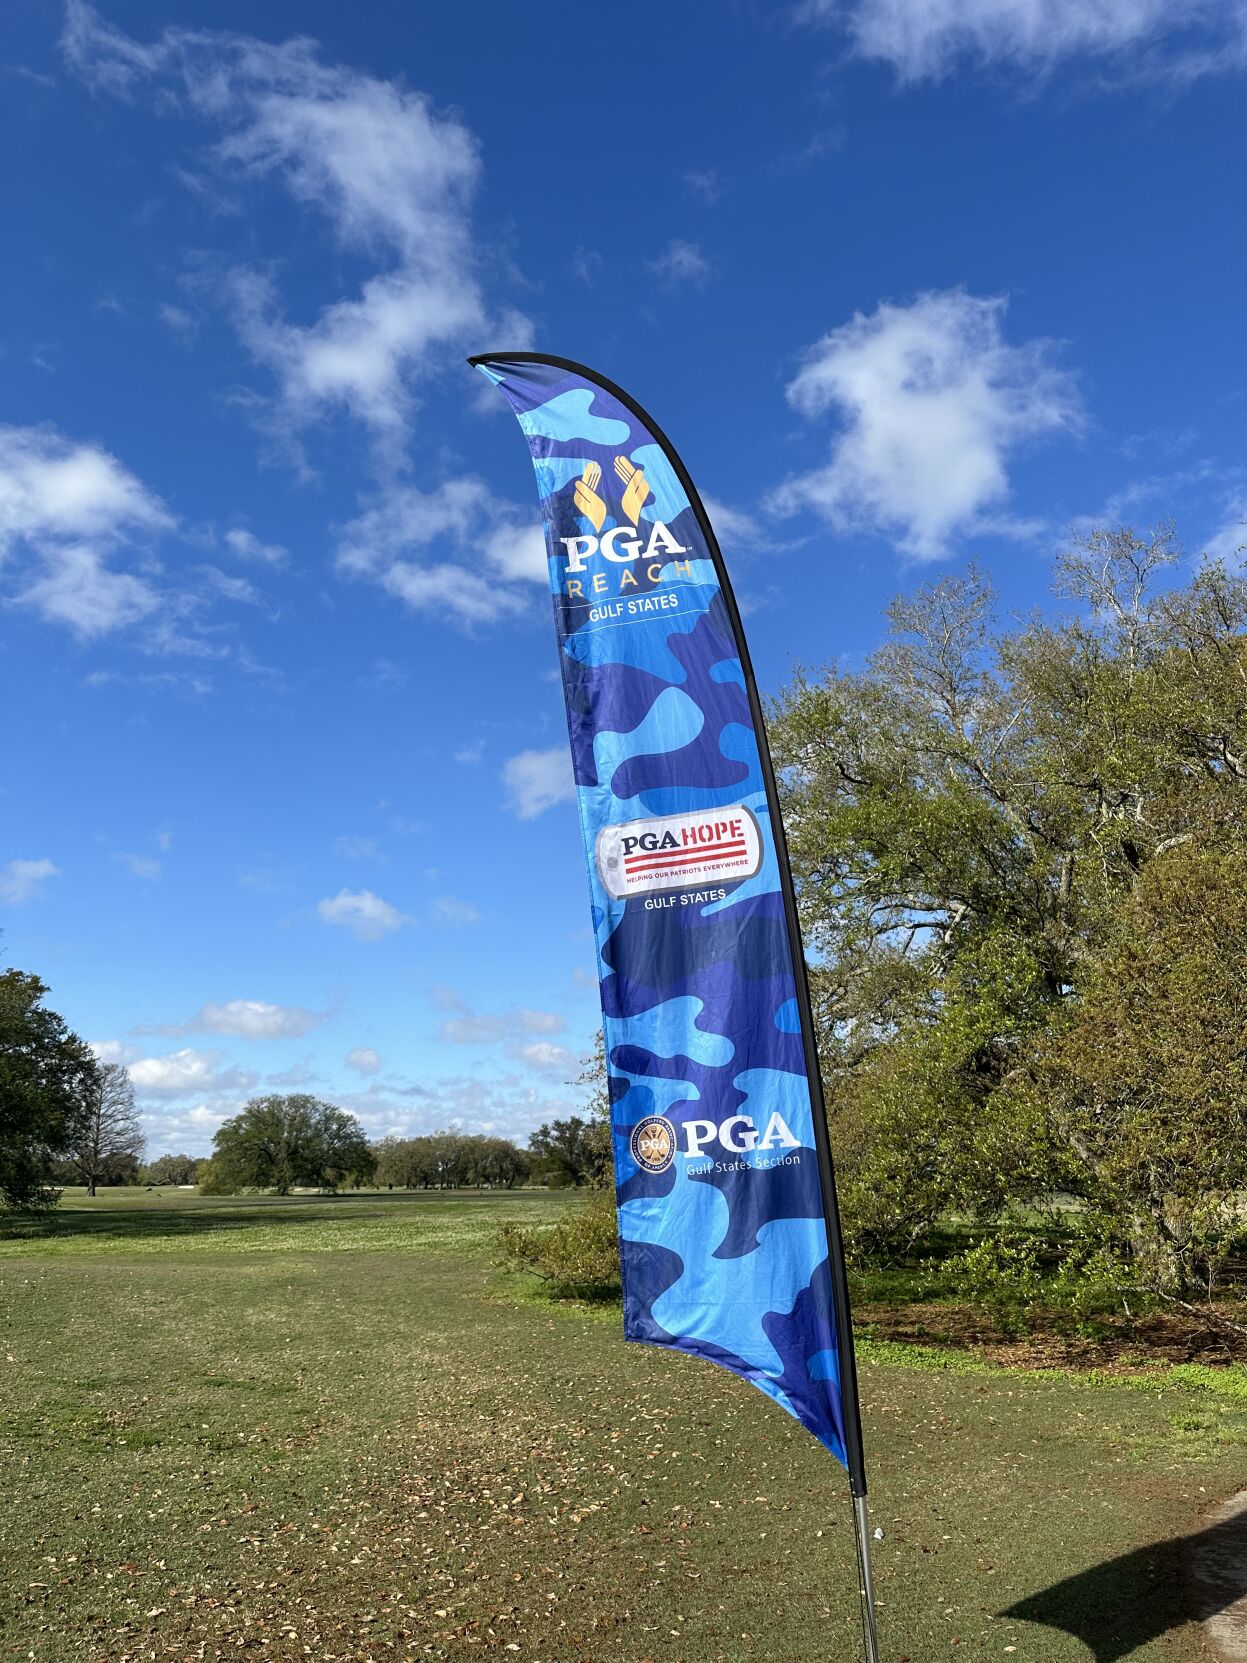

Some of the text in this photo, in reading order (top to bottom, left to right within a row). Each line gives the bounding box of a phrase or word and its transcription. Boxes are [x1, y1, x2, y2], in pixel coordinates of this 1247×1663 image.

[560, 520, 686, 573] PGA
[567, 560, 691, 598] REACH
[589, 594, 678, 622] GULF STATES
[626, 873, 653, 884] HELPING
[670, 867, 701, 877] PATRIOTS
[703, 859, 749, 872] EVERYWHERE
[644, 888, 726, 910] GULF STATES
[639, 1138, 669, 1151] PGA
[682, 1111, 801, 1159] PGA
[686, 1155, 801, 1176] Gulf States Section
